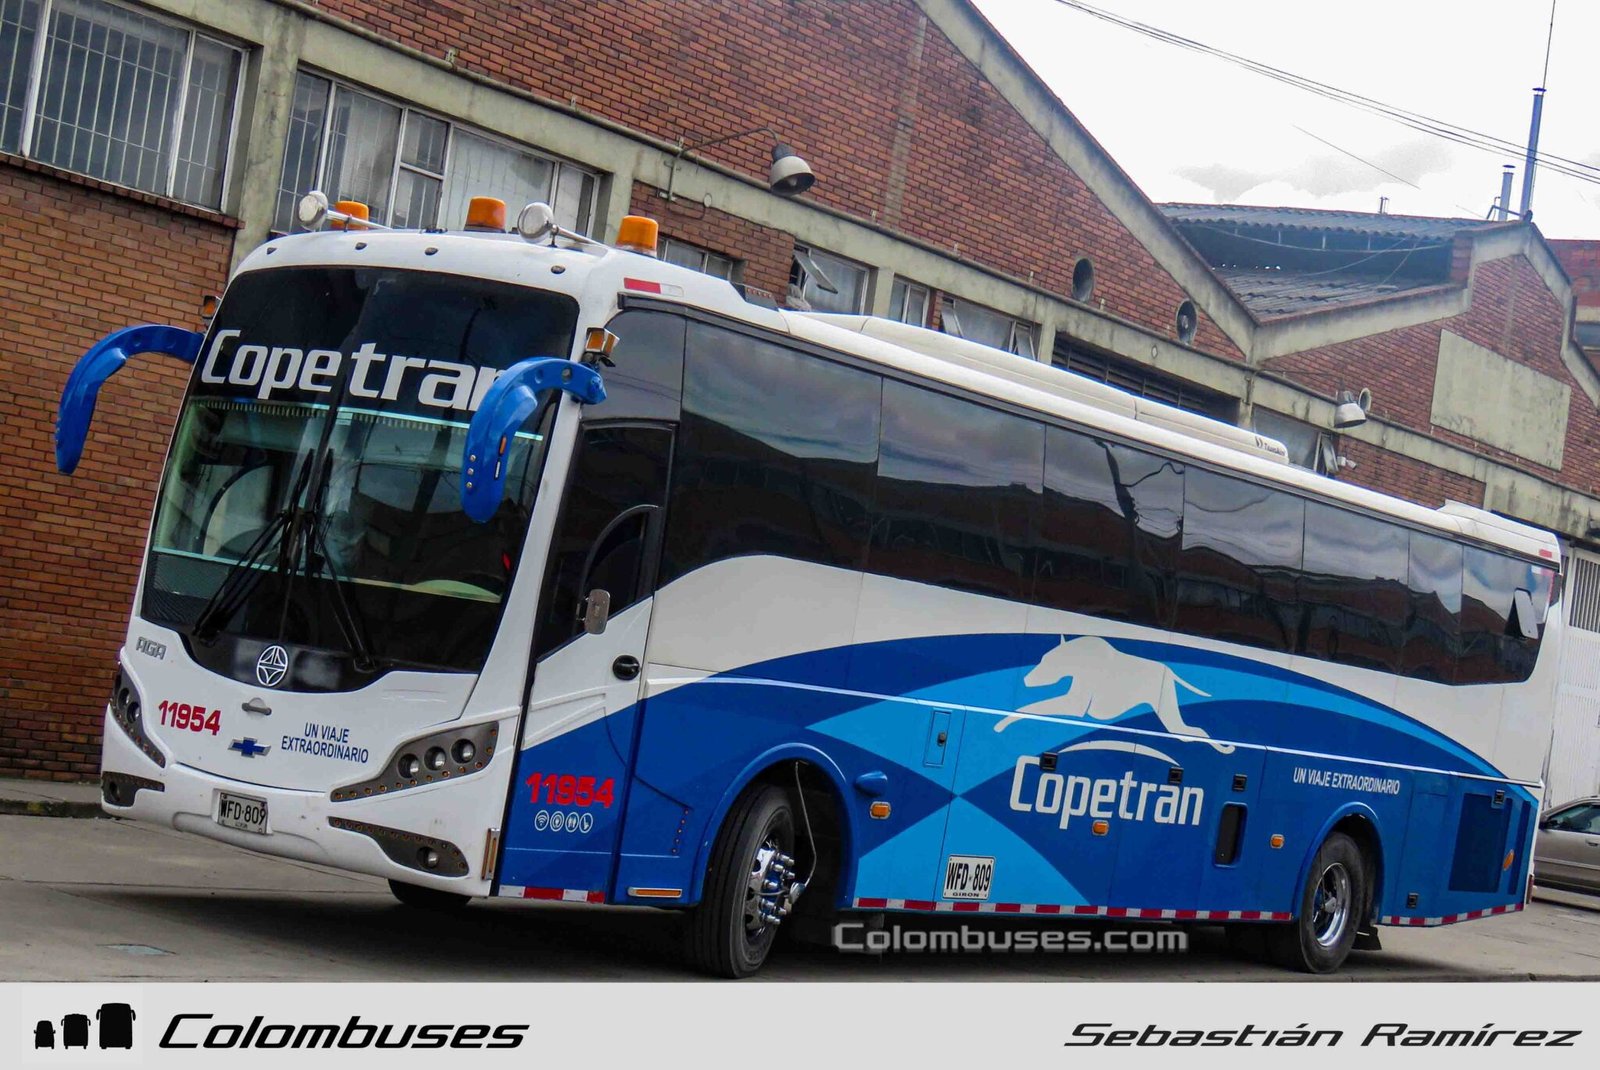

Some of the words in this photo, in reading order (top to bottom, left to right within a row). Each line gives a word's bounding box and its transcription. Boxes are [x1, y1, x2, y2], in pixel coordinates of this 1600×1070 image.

[158, 700, 221, 736] 11954
[304, 722, 320, 739] UN
[321, 724, 350, 744] VIAJE
[281, 735, 369, 764] EXTRAORDINARIO
[525, 771, 615, 809] 11954
[1009, 755, 1204, 830] Copetran
[1293, 767, 1307, 784] UN
[1308, 769, 1331, 787] VIAJE
[1331, 772, 1400, 795] EXTRAORDINARIO
